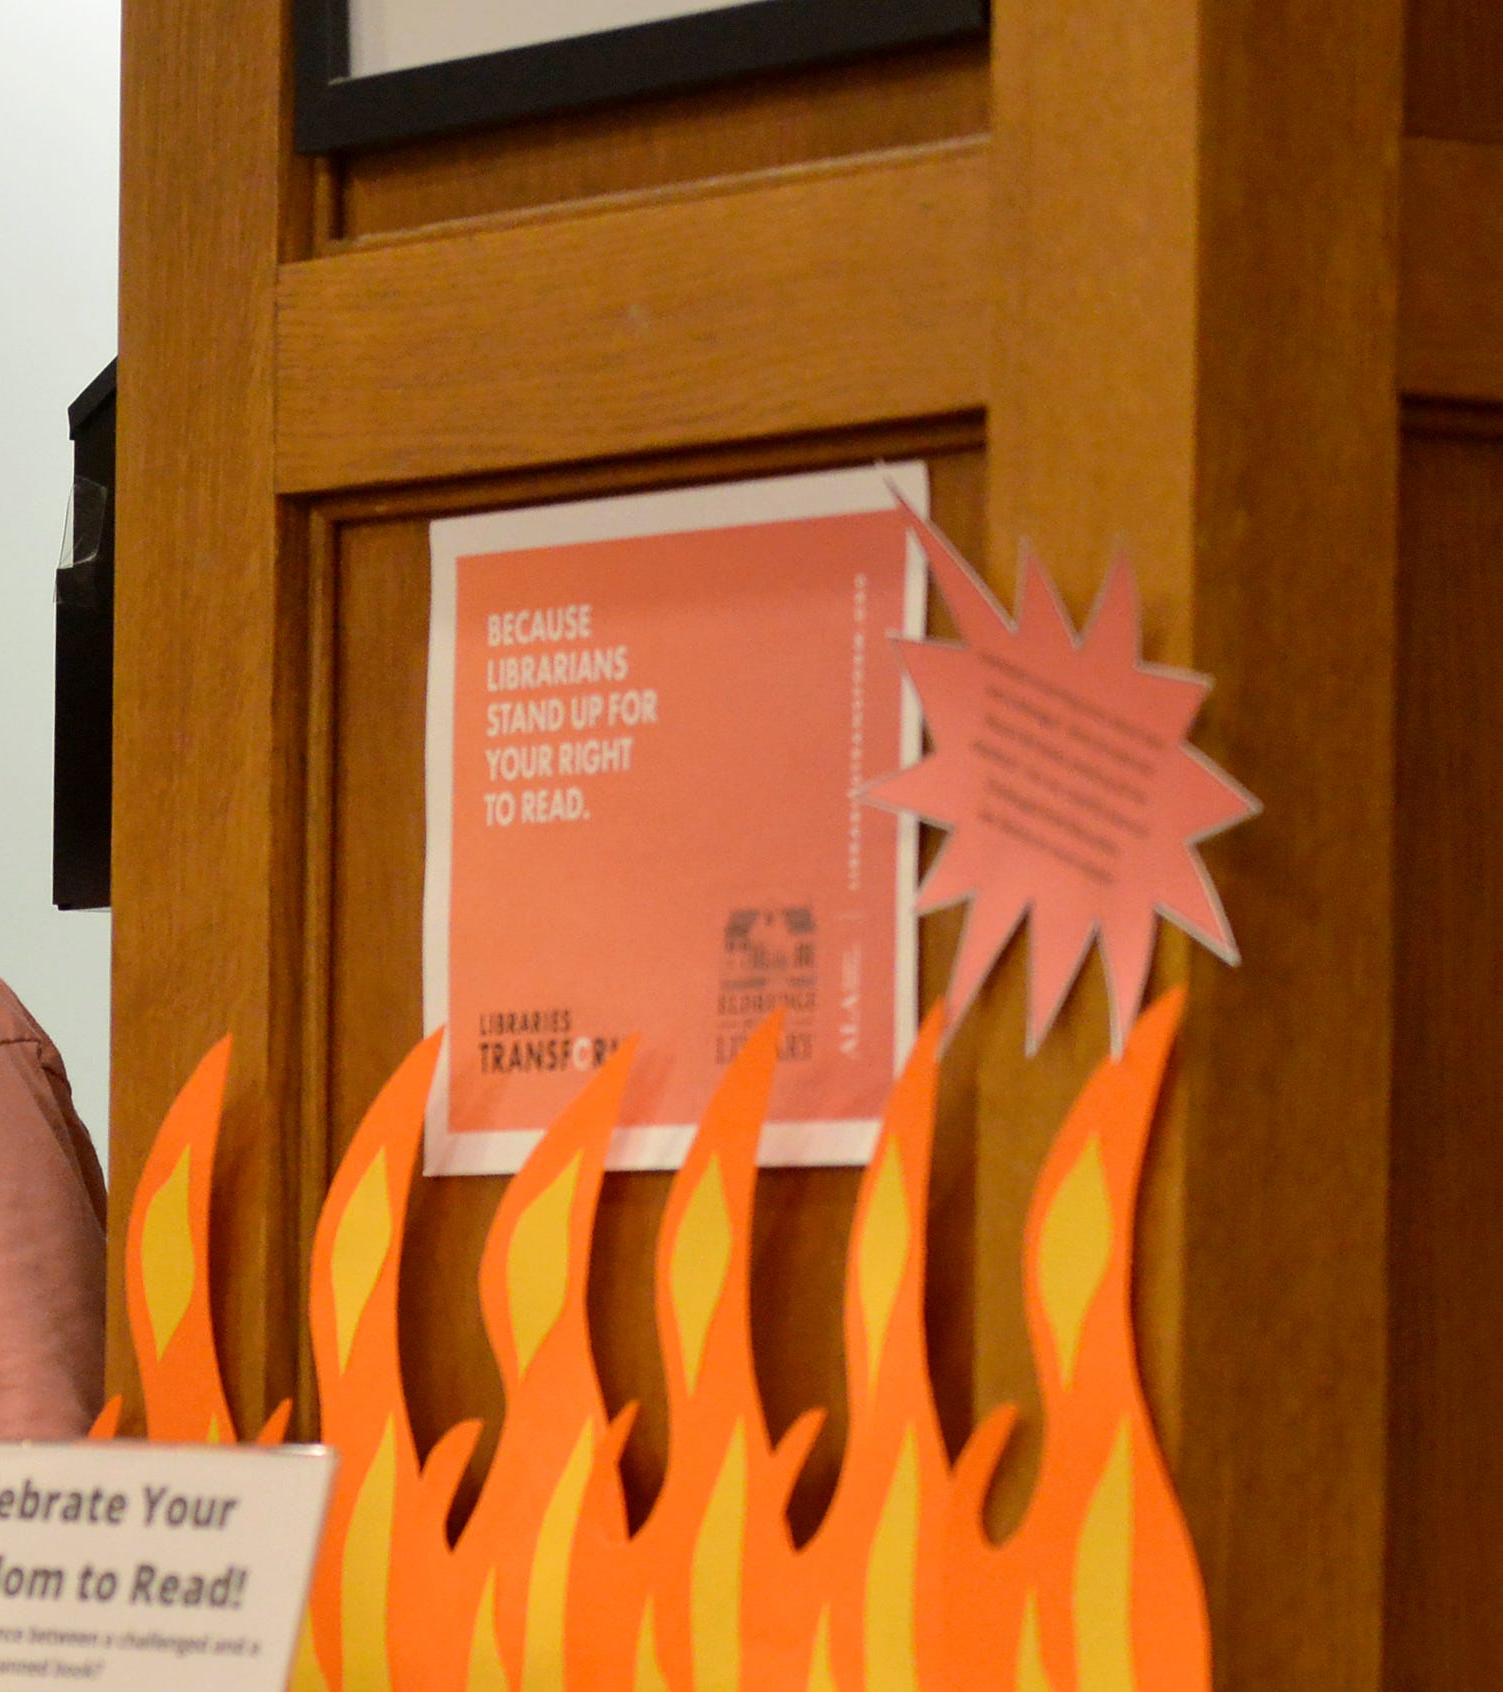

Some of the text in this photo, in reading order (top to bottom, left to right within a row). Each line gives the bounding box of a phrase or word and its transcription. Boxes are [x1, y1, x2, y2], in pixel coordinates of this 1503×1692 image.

[487, 603, 591, 647] BECAUSE
[486, 645, 629, 691] LIBRARIANS
[486, 689, 658, 737] STAND UP FOR
[485, 737, 633, 781] YOUR RIGHT
[484, 787, 591, 827] TO READ.
[479, 1009, 572, 1036] LIBRARIES
[143, 1484, 240, 1530] Your
[78, 1562, 118, 1603] to
[130, 1562, 249, 1609] Read!
